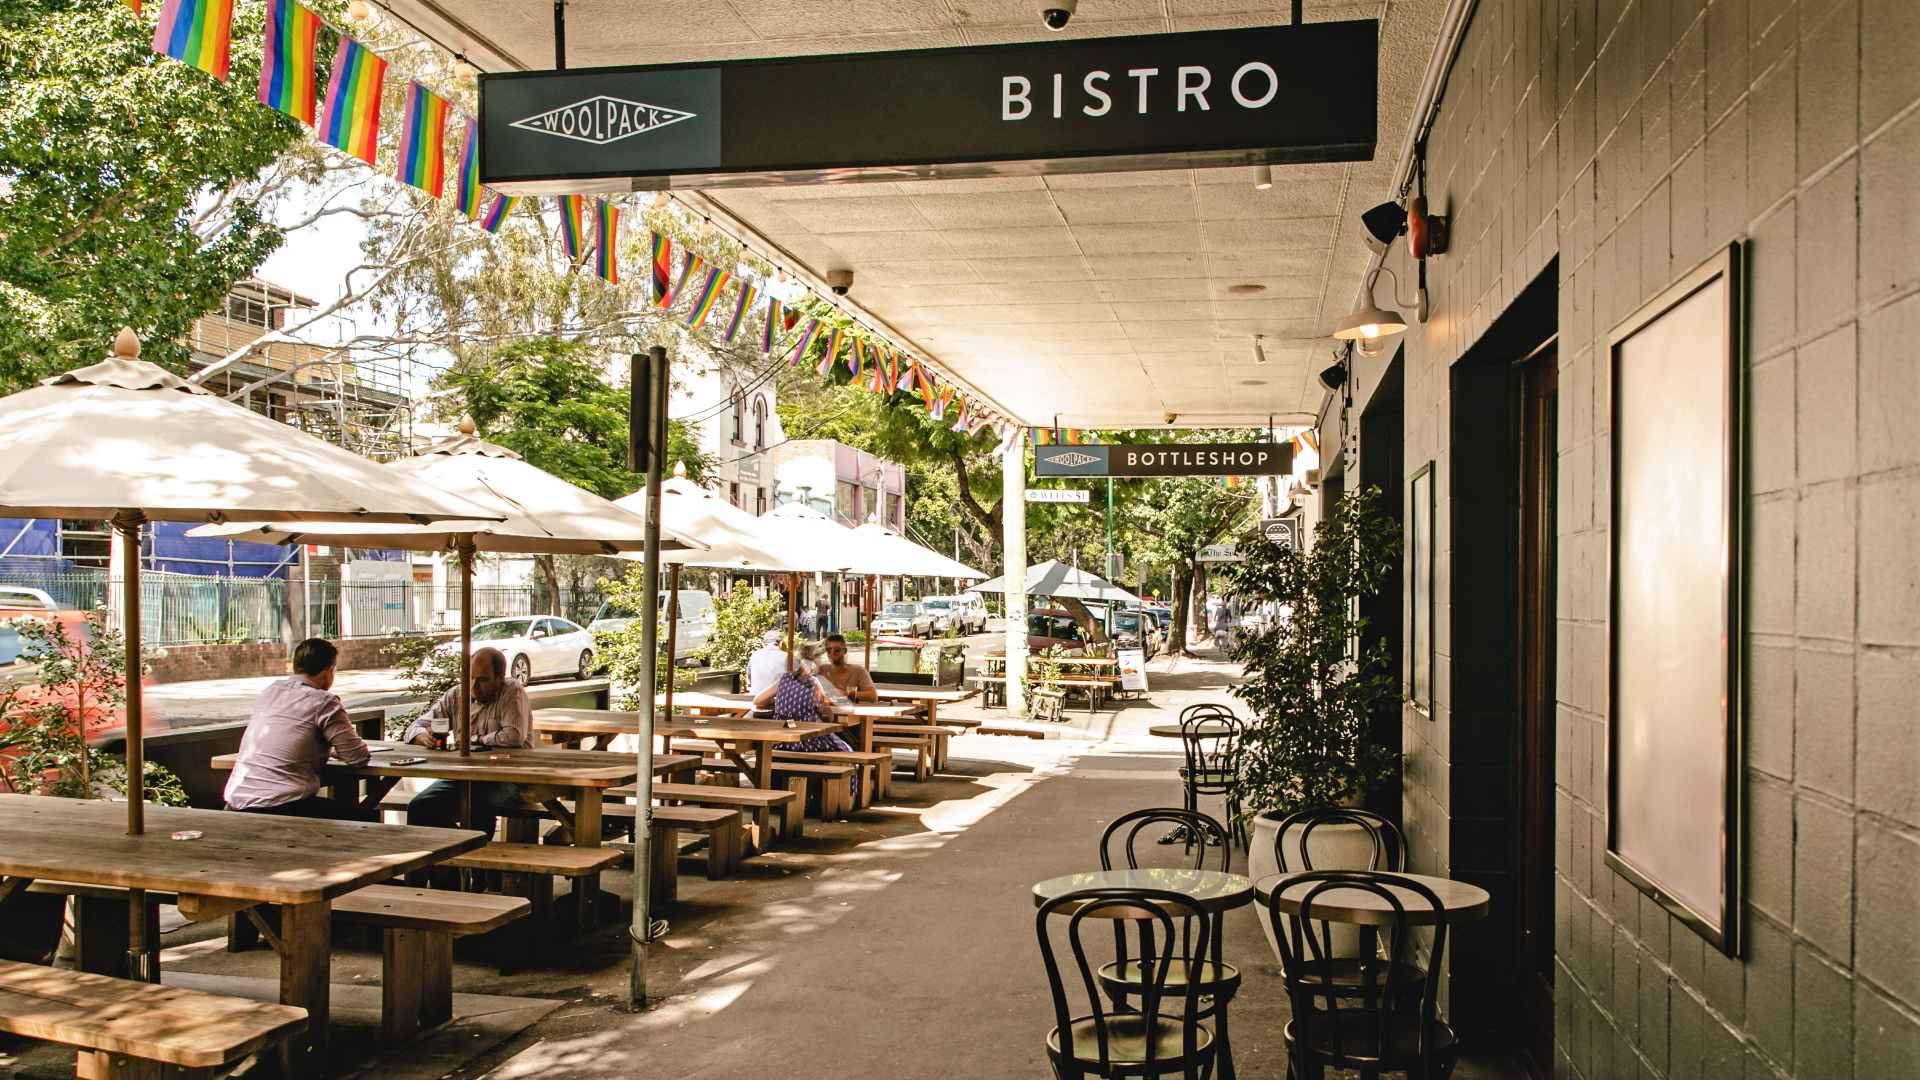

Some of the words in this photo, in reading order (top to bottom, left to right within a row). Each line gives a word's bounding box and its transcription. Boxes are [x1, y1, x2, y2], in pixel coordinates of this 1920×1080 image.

[1002, 61, 1279, 121] BISTRO
[544, 100, 660, 139] WOOLPACK
[1053, 453, 1091, 465] WOOLPACK
[1127, 451, 1268, 466] BOTTLESHOP
